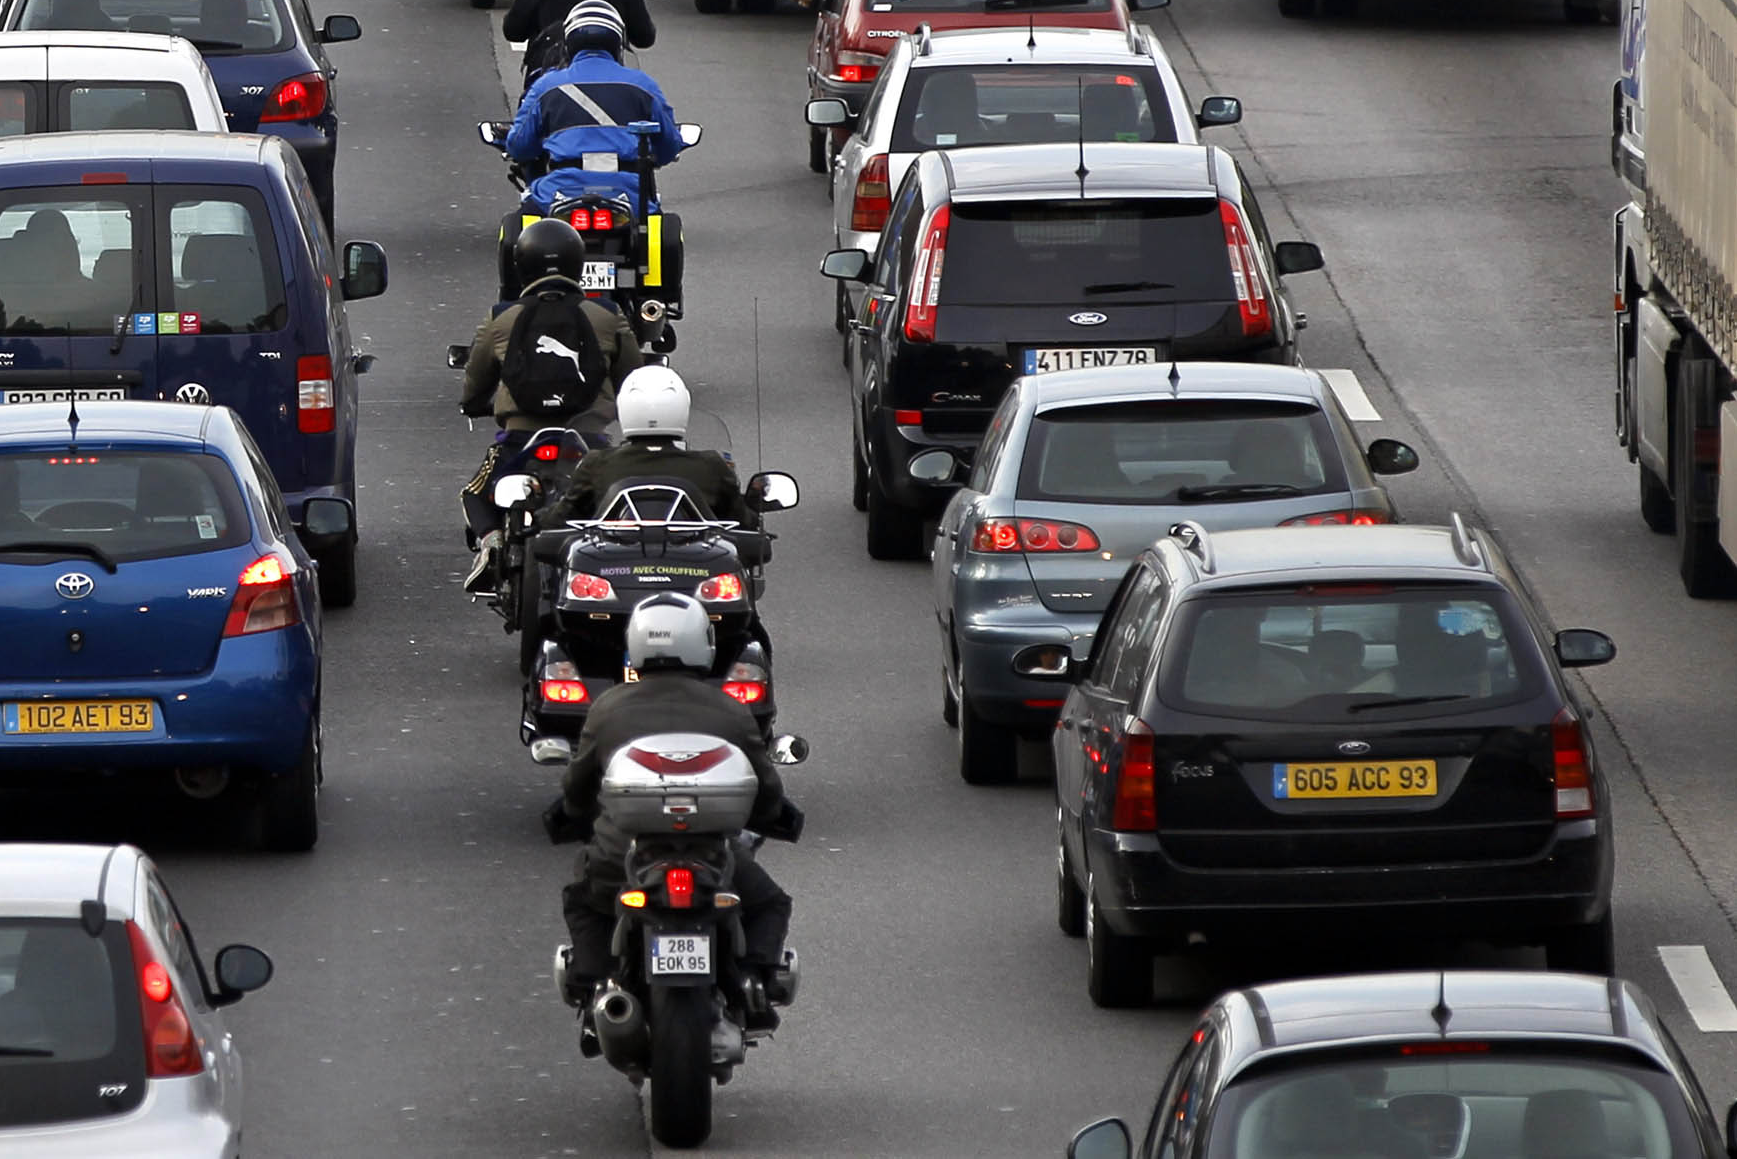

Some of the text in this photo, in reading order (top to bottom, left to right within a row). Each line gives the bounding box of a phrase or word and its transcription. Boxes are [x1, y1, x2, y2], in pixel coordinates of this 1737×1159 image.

[240, 86, 265, 96] 307
[581, 276, 612, 288] 59-MY
[1037, 351, 1074, 371] 411
[600, 566, 710, 578] MOTOS AVEC CHAUFFEURS
[186, 586, 227, 599] YARIS
[648, 630, 671, 639] BMW
[26, 703, 149, 729] 102 AET 93
[1294, 768, 1429, 792] 605 ACC 93
[668, 939, 695, 954] 288
[657, 956, 706, 971] EOK 95
[100, 1085, 129, 1098] 107
